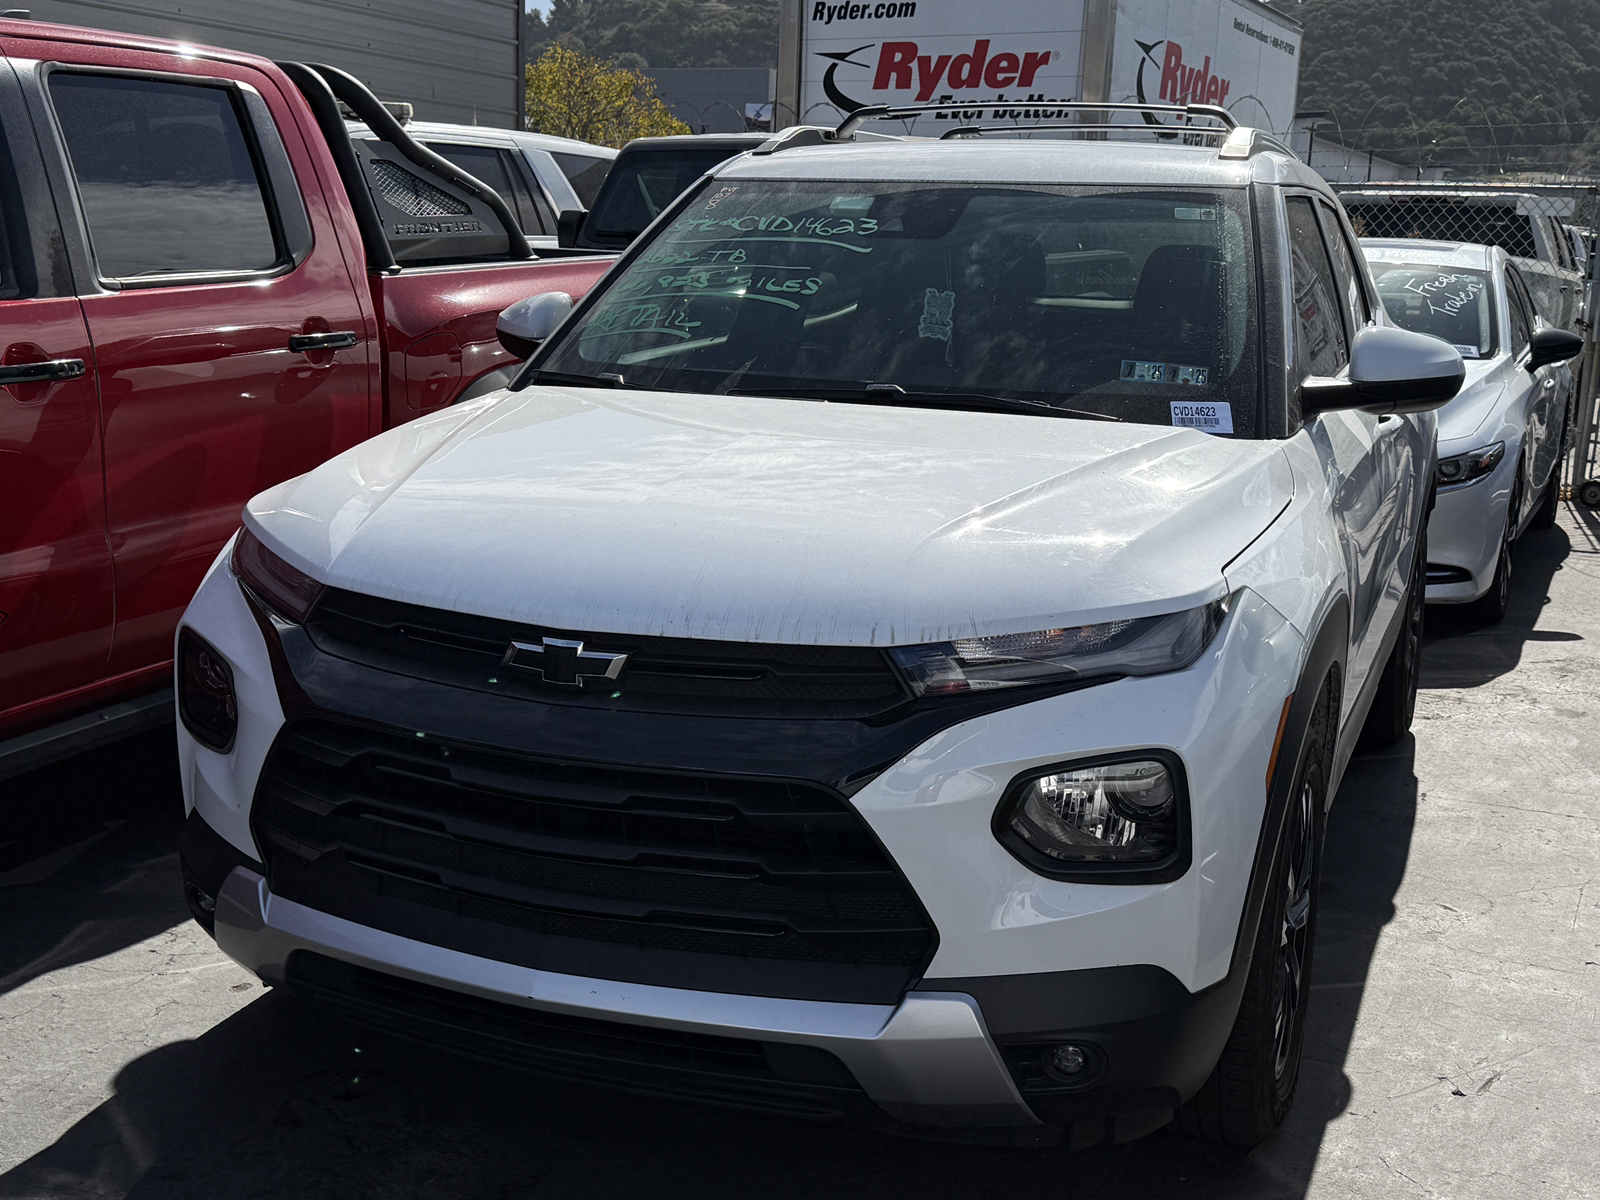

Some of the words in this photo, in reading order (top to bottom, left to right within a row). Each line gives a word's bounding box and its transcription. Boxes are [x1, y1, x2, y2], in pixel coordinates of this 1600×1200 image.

[812, 0, 917, 25] Ryder.com
[872, 39, 1051, 102] Ryder
[1159, 40, 1231, 121] Ryder
[393, 220, 483, 237] FRONTIER
[1151, 364, 1163, 380] 25
[1195, 368, 1207, 384] 25
[1173, 405, 1217, 417] CVD14623
